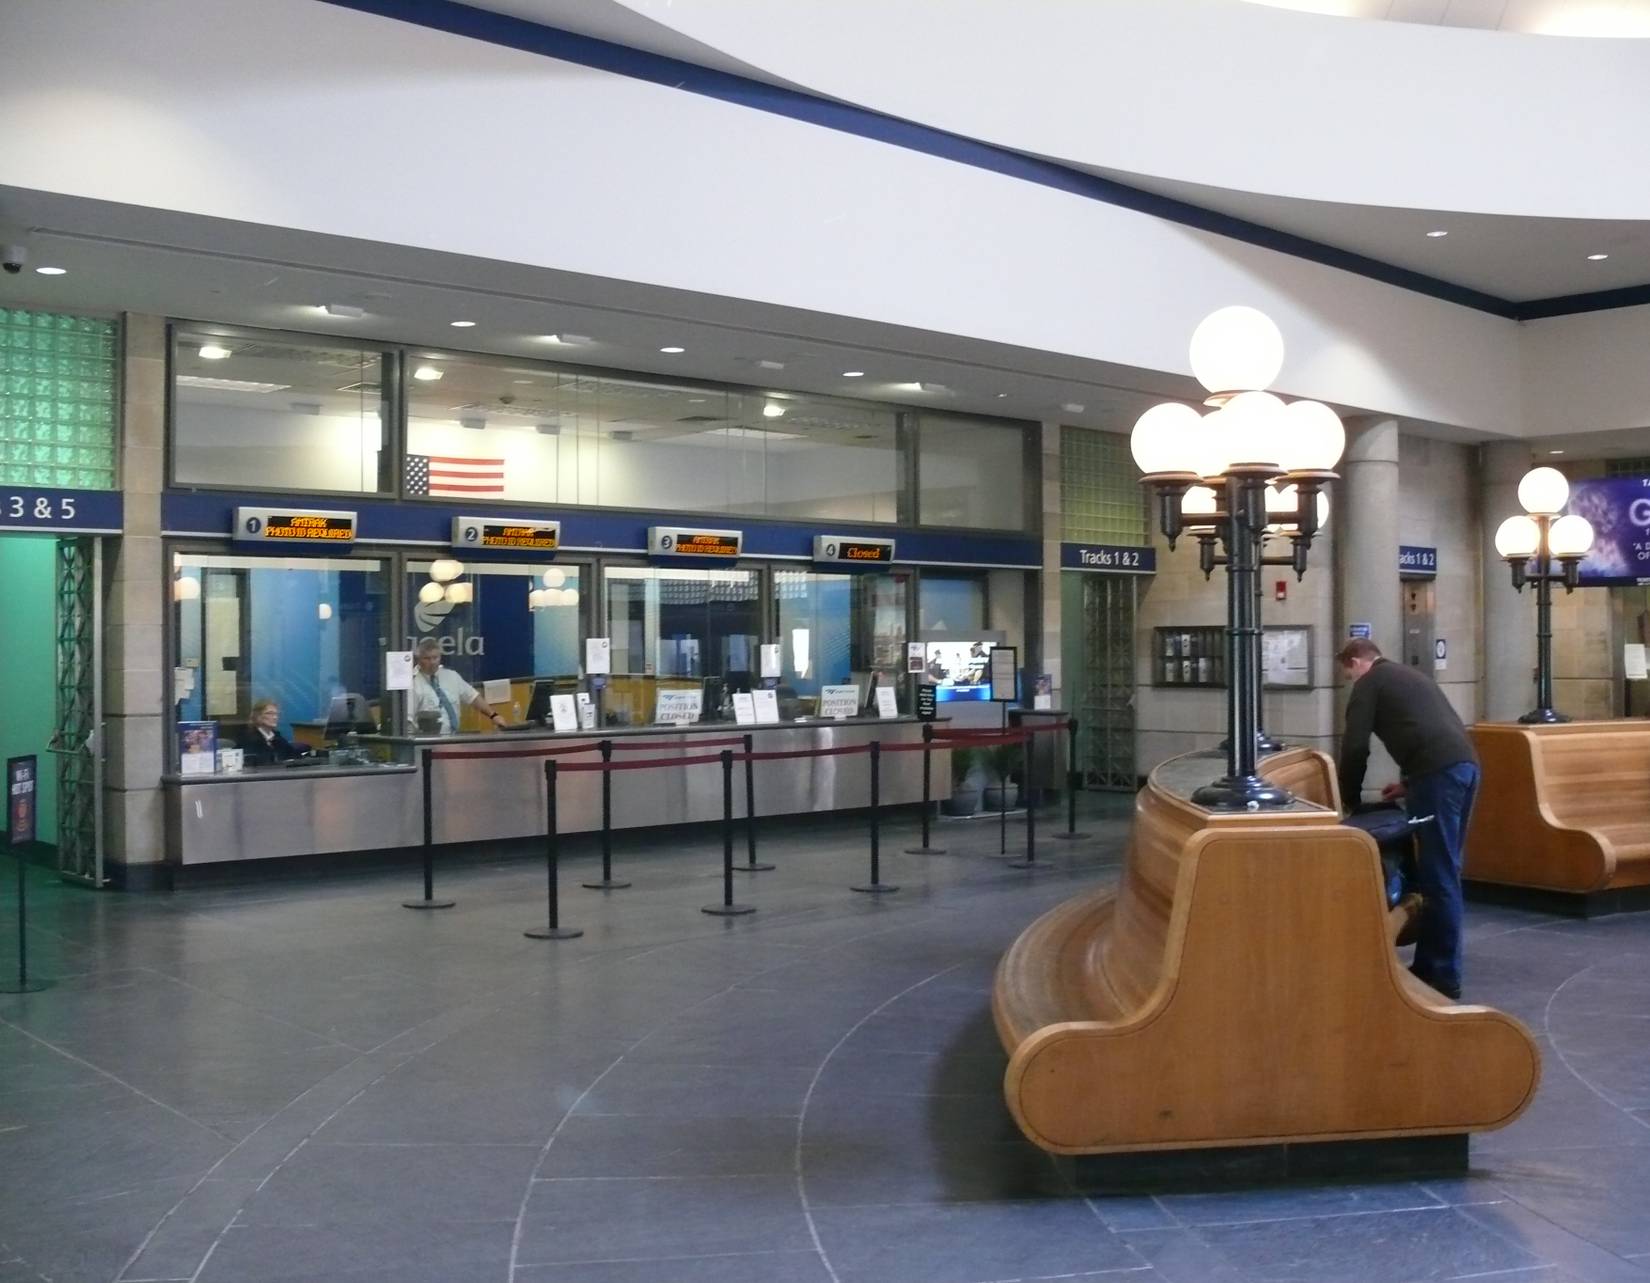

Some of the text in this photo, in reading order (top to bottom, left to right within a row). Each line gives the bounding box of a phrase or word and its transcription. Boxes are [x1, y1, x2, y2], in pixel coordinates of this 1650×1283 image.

[9, 496, 24, 518] 3
[33, 497, 52, 519] &
[61, 498, 76, 519] 5
[249, 519, 257, 532] 1
[306, 528, 353, 539] REQUIRED
[467, 527, 476, 541] 2
[663, 536, 671, 549] 3
[847, 547, 881, 559] Closed
[1079, 549, 1139, 567] Tracks 1 & 2
[1429, 553, 1434, 566] 2
